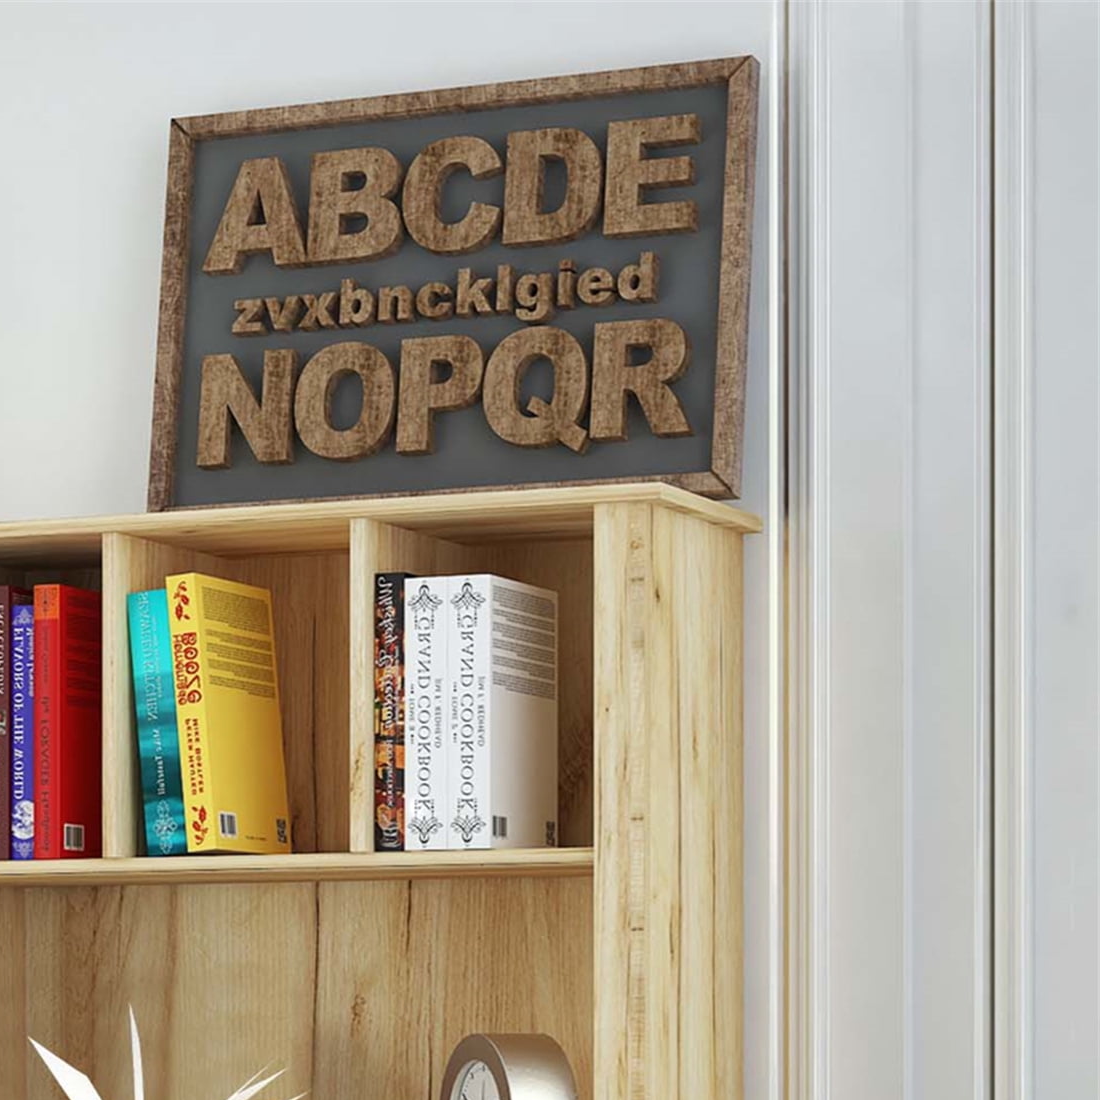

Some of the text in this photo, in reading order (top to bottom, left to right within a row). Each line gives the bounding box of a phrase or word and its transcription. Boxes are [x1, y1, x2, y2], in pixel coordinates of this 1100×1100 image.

[203, 114, 700, 275] ABCDE
[232, 252, 661, 336] zvxbncklgied
[196, 318, 696, 470] NOPQR
